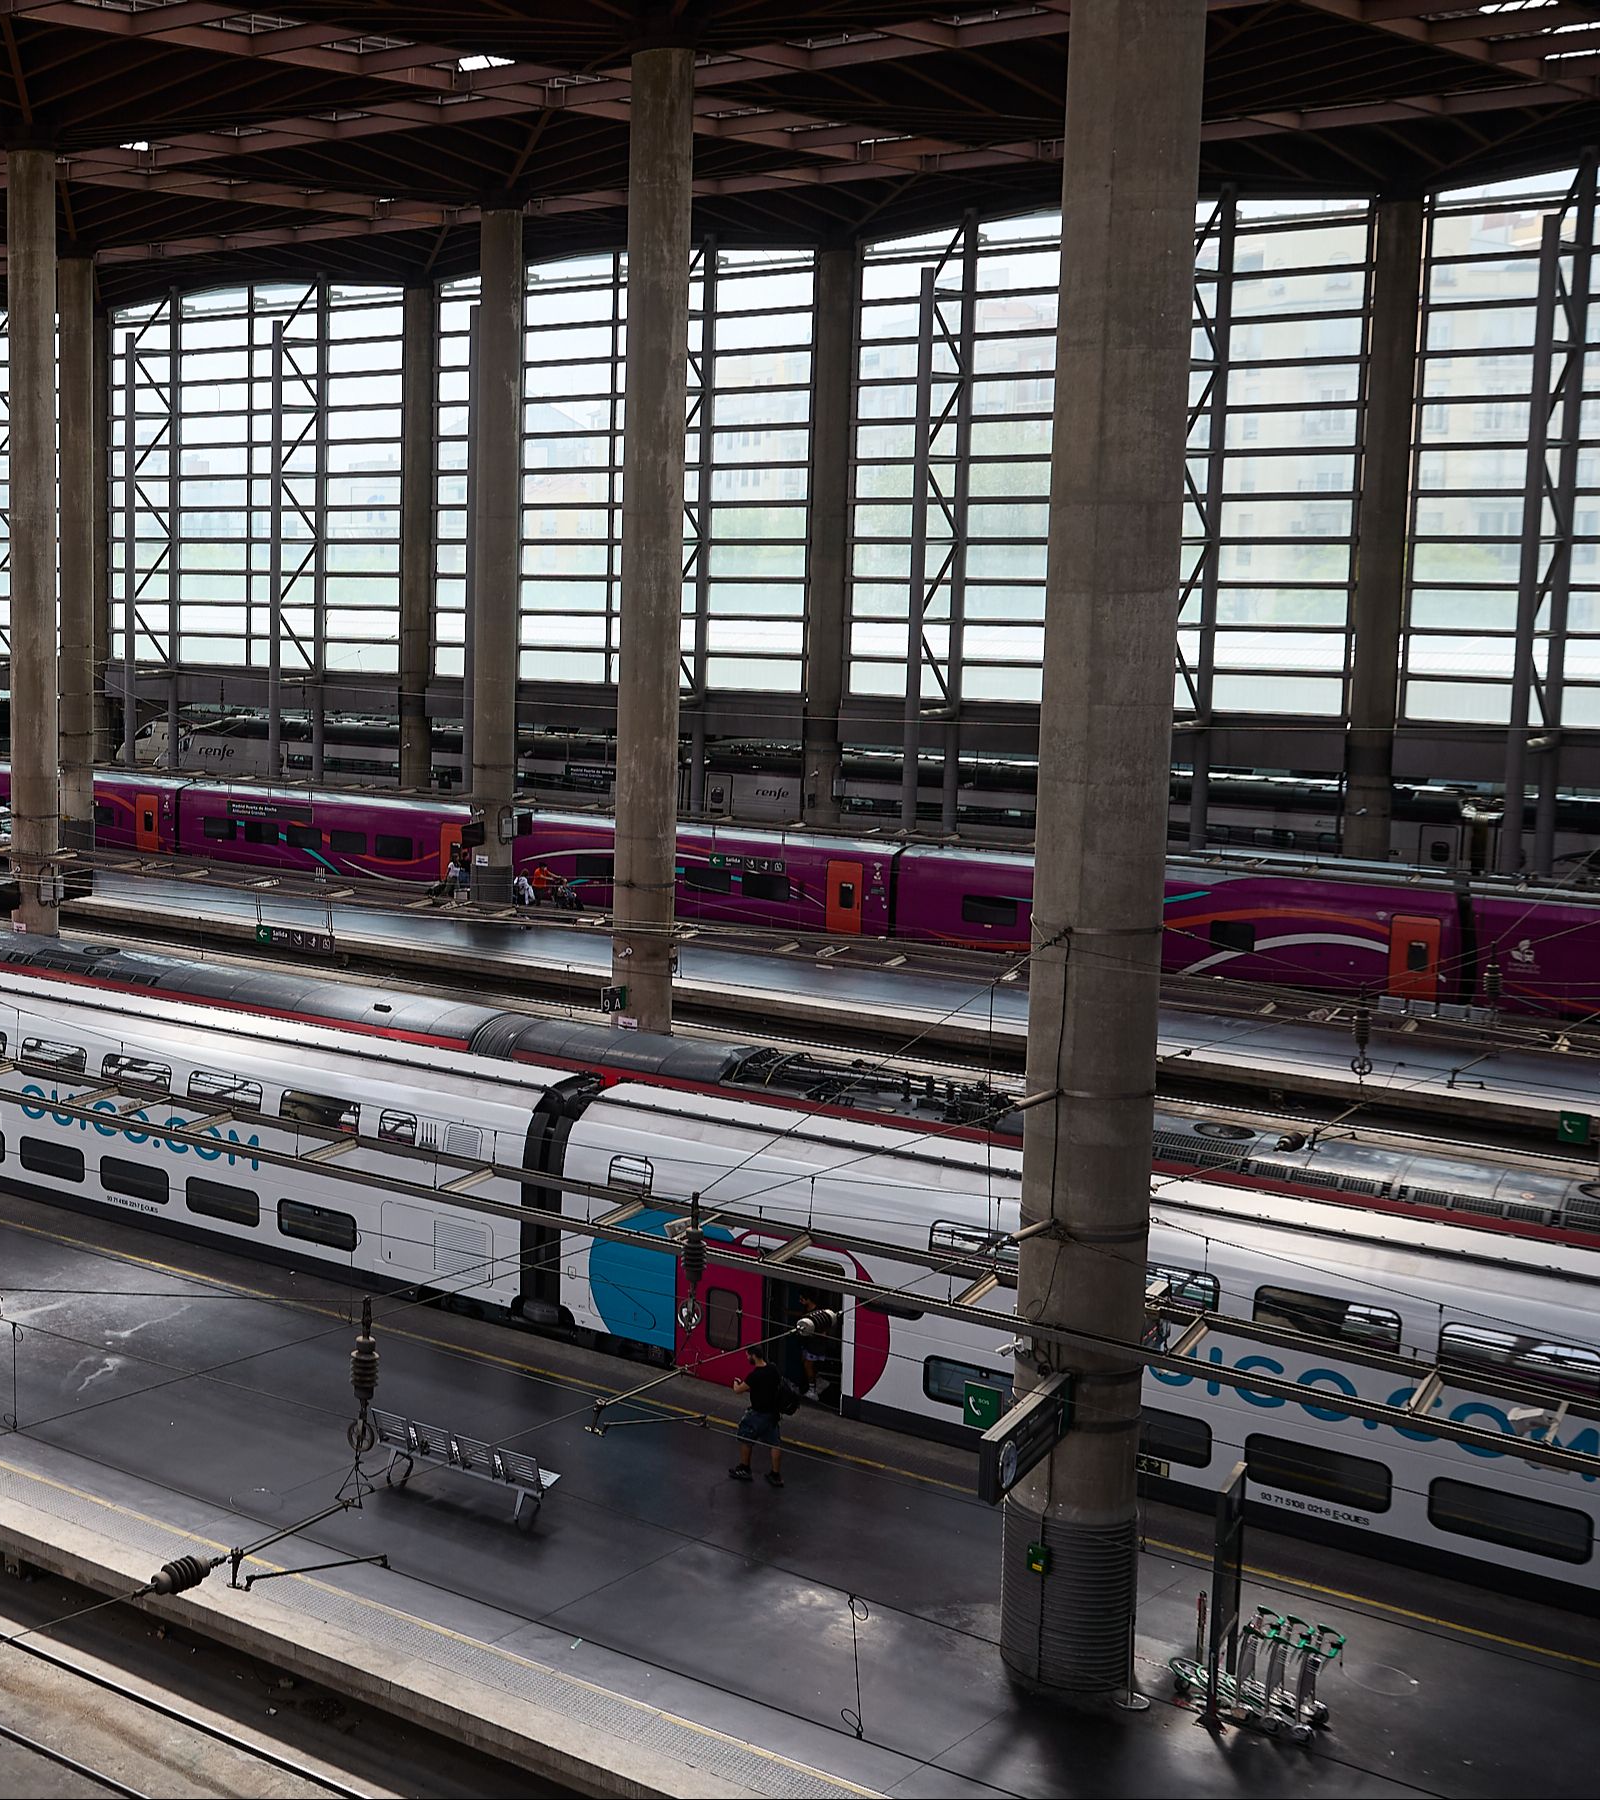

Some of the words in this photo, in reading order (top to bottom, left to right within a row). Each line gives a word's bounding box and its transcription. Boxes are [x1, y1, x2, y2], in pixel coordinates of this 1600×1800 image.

[199, 744, 235, 760] renfe
[755, 787, 789, 800] renfe
[272, 930, 288, 938] Salida
[604, 999, 610, 1012] 9
[614, 998, 621, 1010] A
[1057, 1408, 1064, 1436] 7
[1260, 1492, 1272, 1501] 93
[1274, 1495, 1284, 1504] 71
[1285, 1498, 1306, 1510] 5108
[1307, 1504, 1331, 1517] 021-8
